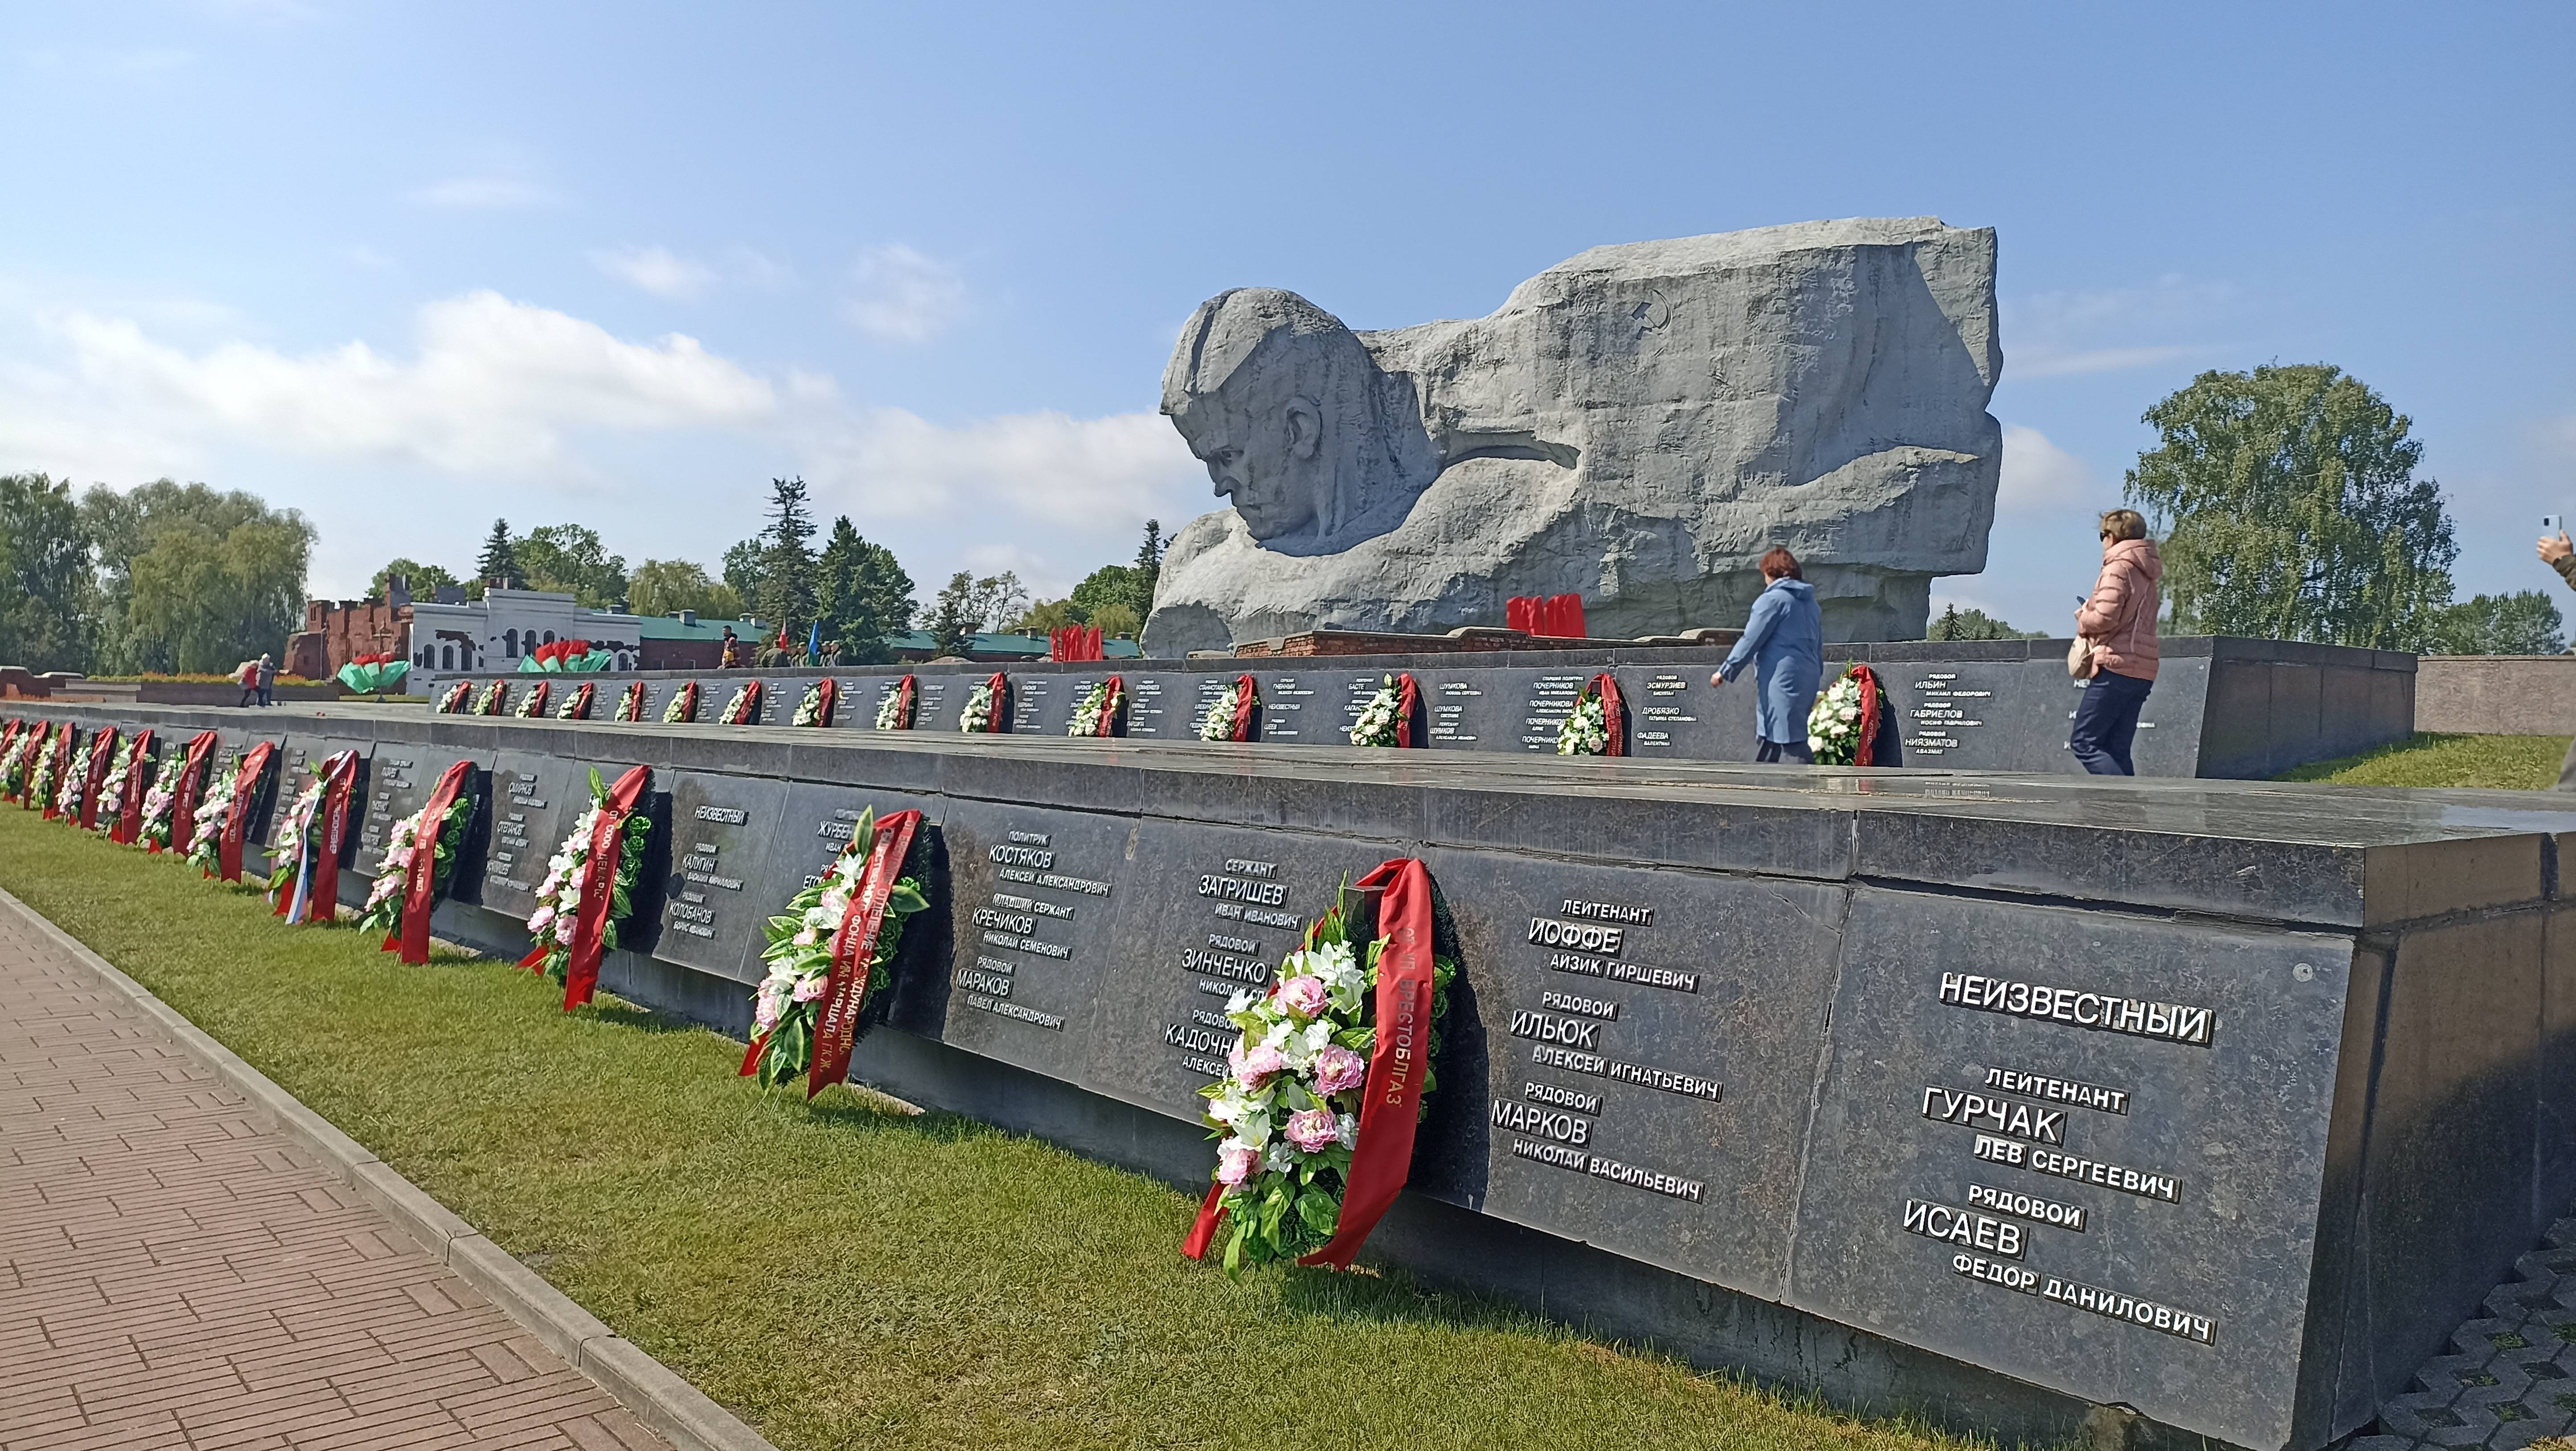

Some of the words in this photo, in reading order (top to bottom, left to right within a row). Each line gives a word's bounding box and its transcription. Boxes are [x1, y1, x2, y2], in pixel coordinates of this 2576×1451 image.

[1915, 681, 1946, 689] ИЛЬИН
[1910, 710, 1963, 718] ГАБРИЕЛОВ
[1905, 738, 1958, 748] НИЯЗМАТОВ
[608, 810, 619, 820] ОТ
[695, 805, 745, 825] НЕИЗВЕСТНЫЙ
[818, 821, 853, 840] ЖУРБЕН
[1009, 830, 1048, 846] ПОЛИТРУК
[826, 842, 841, 852] ИВАН
[989, 845, 1053, 869] КОСТЯКОВ
[682, 854, 715, 873] КАЛУГИН
[1226, 859, 1276, 878] СЕРЖАНТ
[999, 868, 1035, 882] АЛЕКСЕЙ
[1036, 873, 1111, 896] АЛЕКСАНДРОВИЧ
[1198, 875, 1284, 905] ЗАГРИШЕВ
[669, 902, 713, 925] КОЛОБАНОВ
[860, 888, 889, 952] ОТДЕЛЕНИЕ
[993, 893, 1033, 912] МЛАДШИЙ
[1034, 901, 1071, 920] СЕРЖАНТ
[1215, 903, 1242, 920] ИВАН
[1244, 909, 1299, 929] ИВАНОВИЧ
[1561, 899, 1651, 923] ЛЕЙТЕНАНТ
[842, 915, 862, 956] ФОНДА
[972, 908, 1033, 935] КРЕЧИКОВ
[1528, 917, 1621, 953] ИОФФЕ
[984, 931, 1018, 949] НИКОЛАЙ
[1020, 940, 1070, 960] СЕМЕНОВИЧ
[1209, 933, 1256, 954] РЯДОВОЙ
[1399, 928, 1415, 945] ОТ
[977, 957, 1013, 975] РЯДОВОЙ
[1182, 949, 1267, 983] ЗИНЧЕНКО
[1400, 952, 1416, 970] УП
[1551, 954, 1601, 975] АЙЗИК
[1606, 962, 1695, 990] ГИРШЕВИЧ
[956, 970, 1011, 997] МАРАКОВ
[968, 995, 993, 1012] ПАВЕЛ
[993, 1004, 1063, 1031] АЛЕКСАНДРОВИЧ
[1542, 991, 1616, 1019] РЯДОВОЙ
[1940, 973, 2209, 1042] НЕИЗВЕСТНЫЙ
[1165, 1024, 1232, 1058] КАДОЧН
[1510, 1010, 1596, 1048] ИЛЬЮК
[1182, 1056, 1230, 1079] АЛЕКСЕЙ
[1532, 1045, 1605, 1073] АЛЕКСЕЙ
[1610, 1062, 1719, 1100] ИГНАТЬЕВИЧ
[1525, 1082, 1598, 1112] РЯДОВОЙ
[1985, 1068, 2127, 1113] ЛЕЙТЕНАНТ
[1491, 1100, 1589, 1144] МАРКОВ
[1922, 1087, 2063, 1142] ГУРЧАК
[1513, 1139, 1585, 1171] НИКОЛАЙ
[1589, 1158, 1701, 1200] ВАСИЛЬЕВИЧ
[1975, 1135, 2025, 1164] ЛЕВ
[2032, 1151, 2178, 1201] СЕРГЕЕВИЧ
[1969, 1185, 2082, 1229] РЯДОВОЙ
[1903, 1200, 2022, 1255] ИСАЕВ
[1953, 1255, 2036, 1291] ФЕДОР
[2044, 1278, 2213, 1342] ДАНИЛОВИЧ
